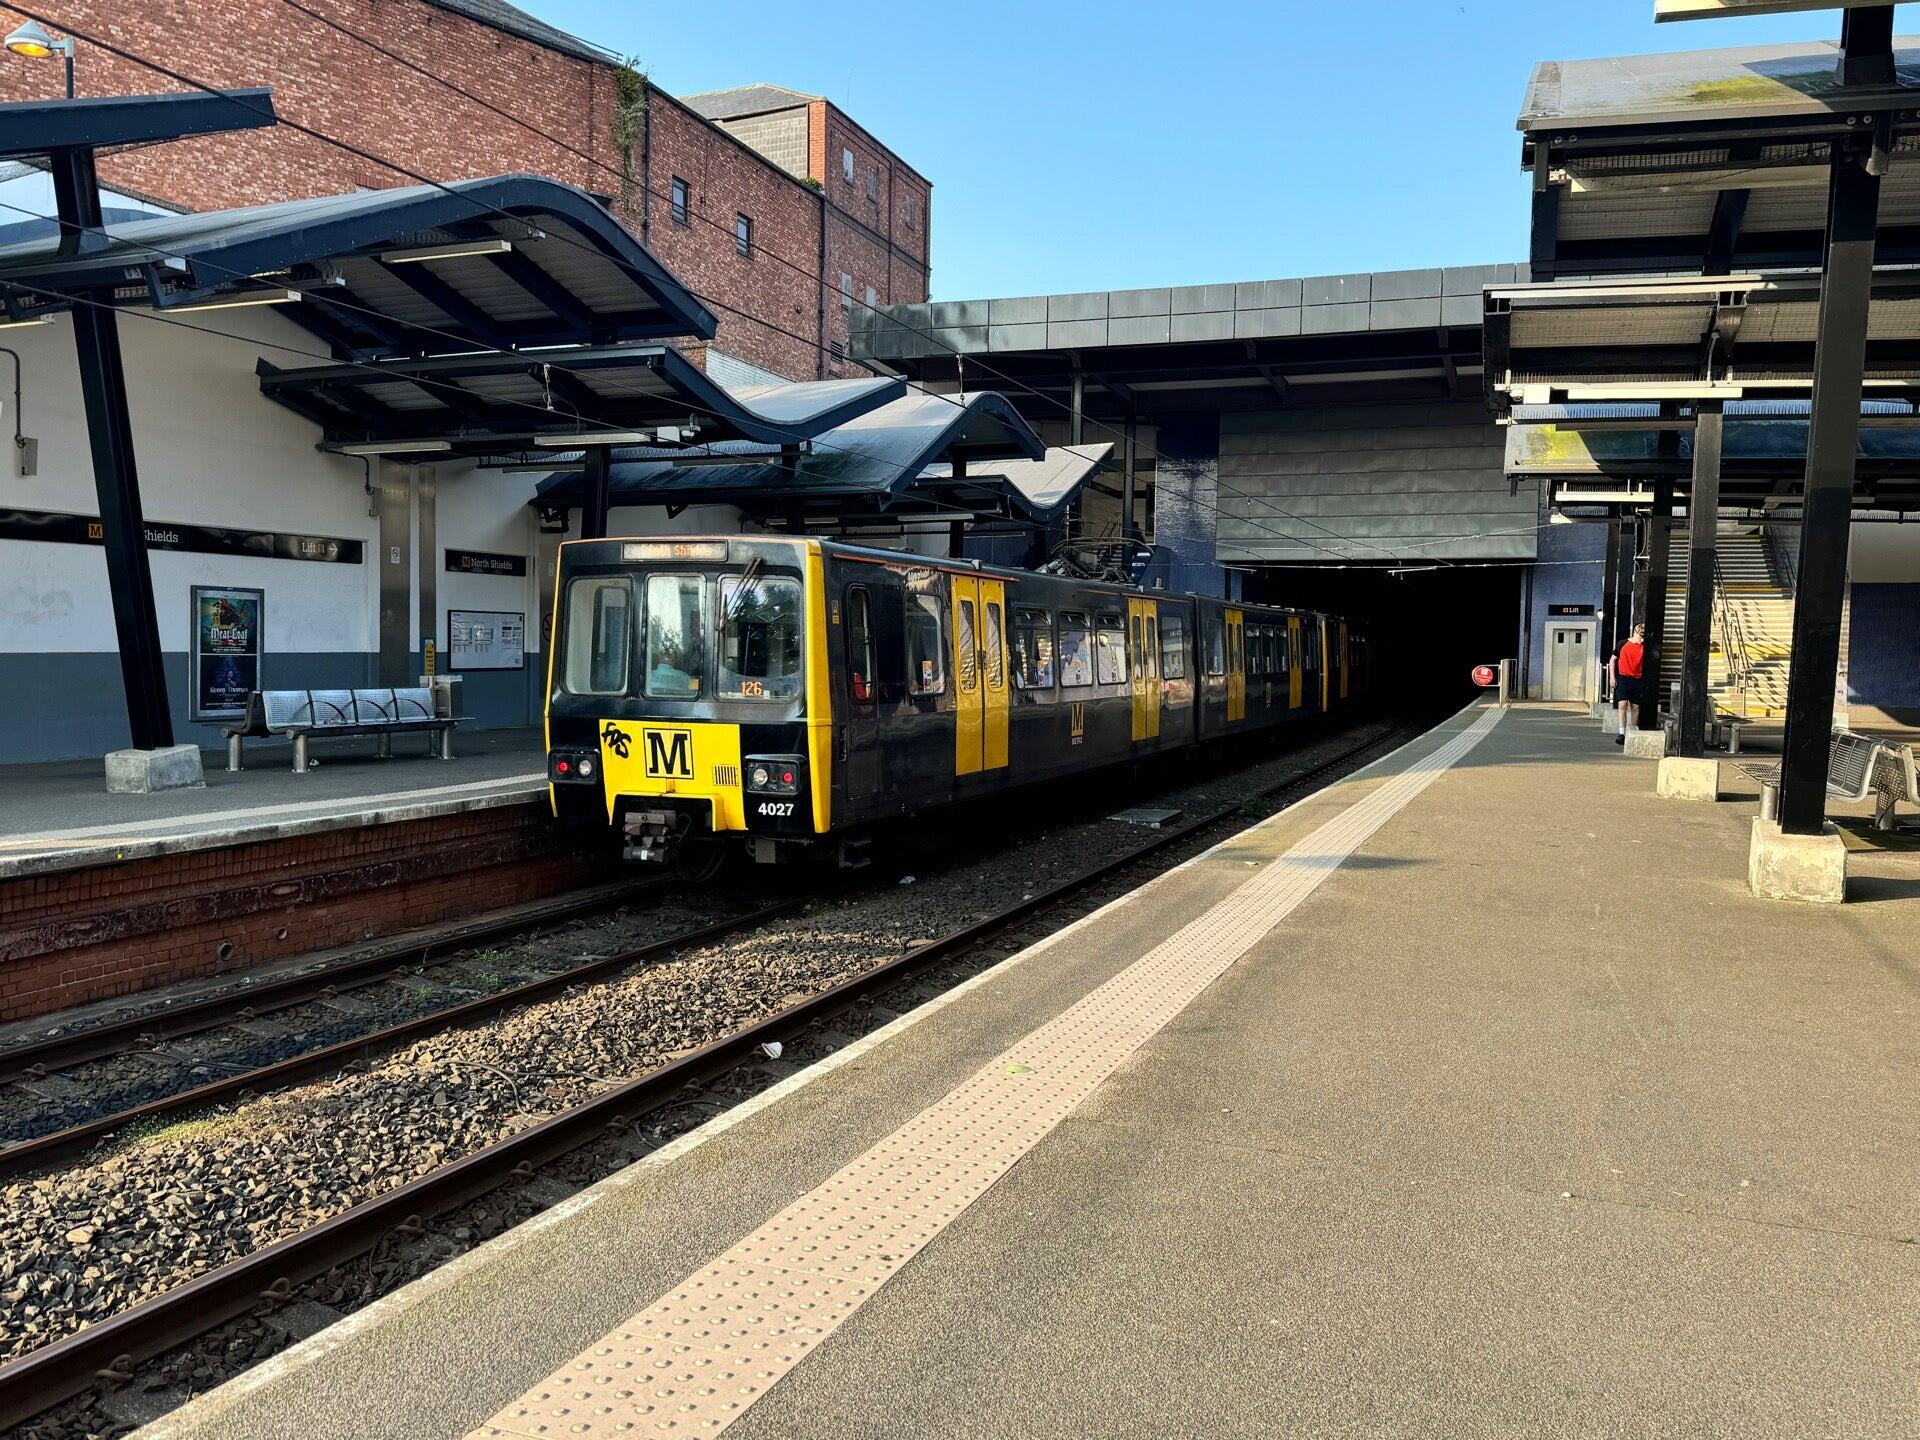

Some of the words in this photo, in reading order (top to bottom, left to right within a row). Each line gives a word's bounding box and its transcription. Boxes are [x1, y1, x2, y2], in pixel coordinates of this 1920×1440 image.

[302, 542, 316, 553] Lift
[471, 557, 490, 568] North
[490, 559, 513, 570] Shields
[741, 681, 763, 696] 126
[647, 732, 691, 775] M
[758, 803, 794, 816] 4027
